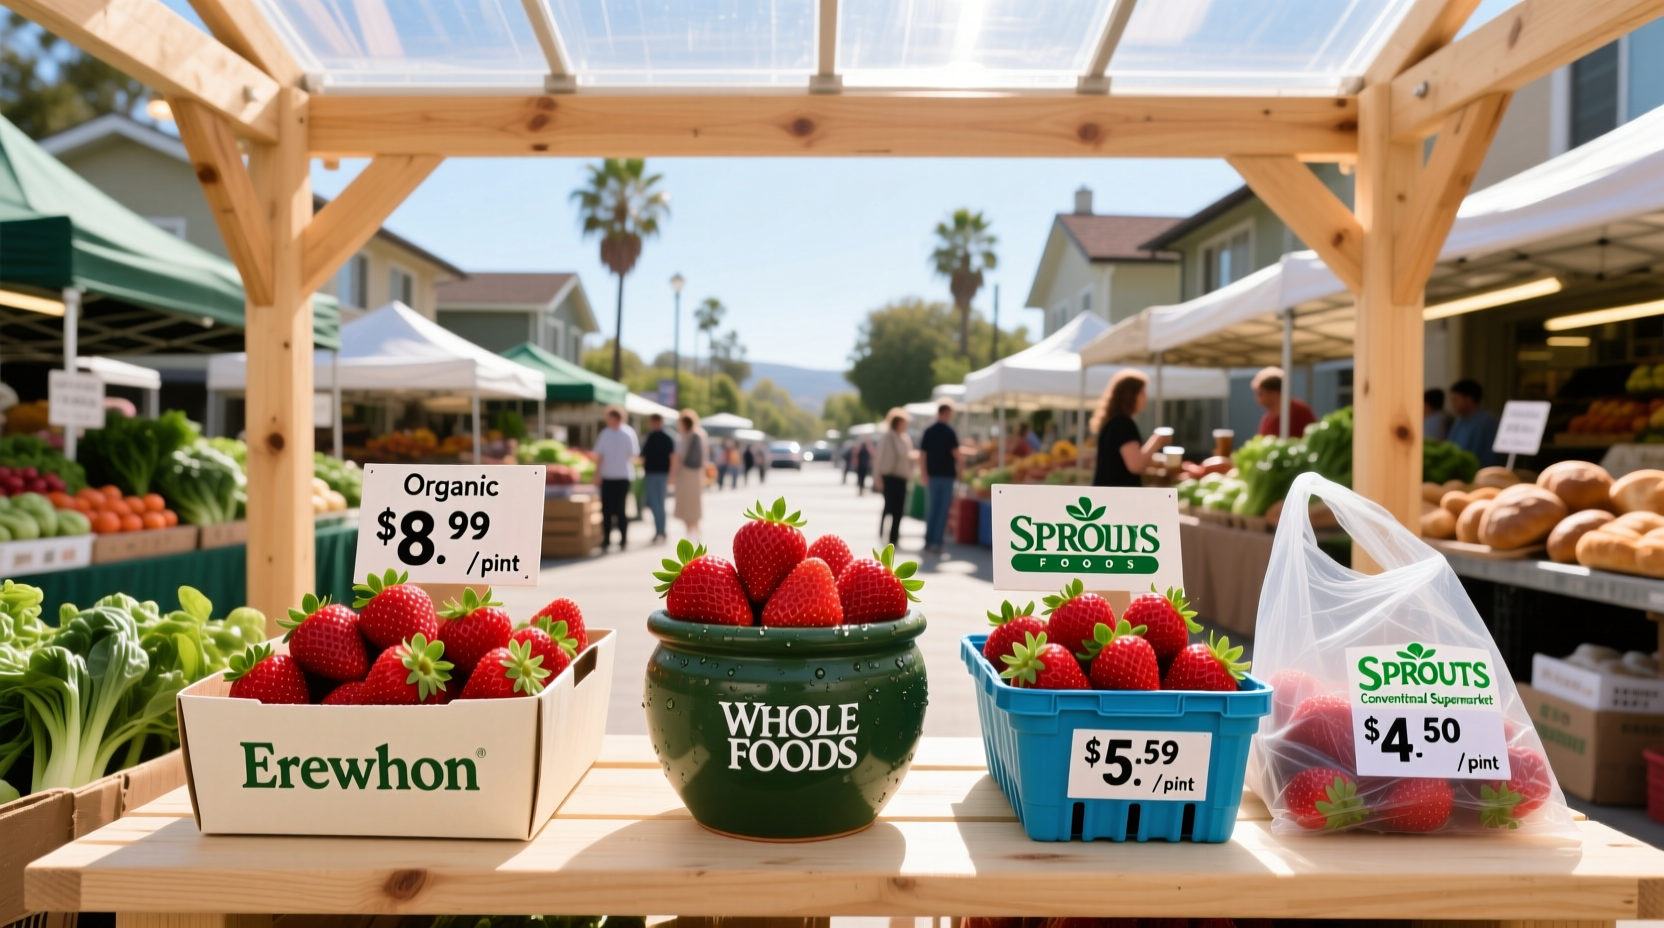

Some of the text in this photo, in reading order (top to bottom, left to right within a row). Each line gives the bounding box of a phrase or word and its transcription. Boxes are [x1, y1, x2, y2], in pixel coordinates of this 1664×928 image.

[403, 472, 499, 502] Organic
[376, 507, 490, 566] $8.99
[466, 551, 520, 578] /pint
[1357, 656, 1491, 692] SPROUTS
[718, 701, 860, 738] WHOLE
[727, 736, 858, 773] FOODS
[1364, 715, 1461, 762] $4.50
[1152, 773, 1195, 795] /pint
